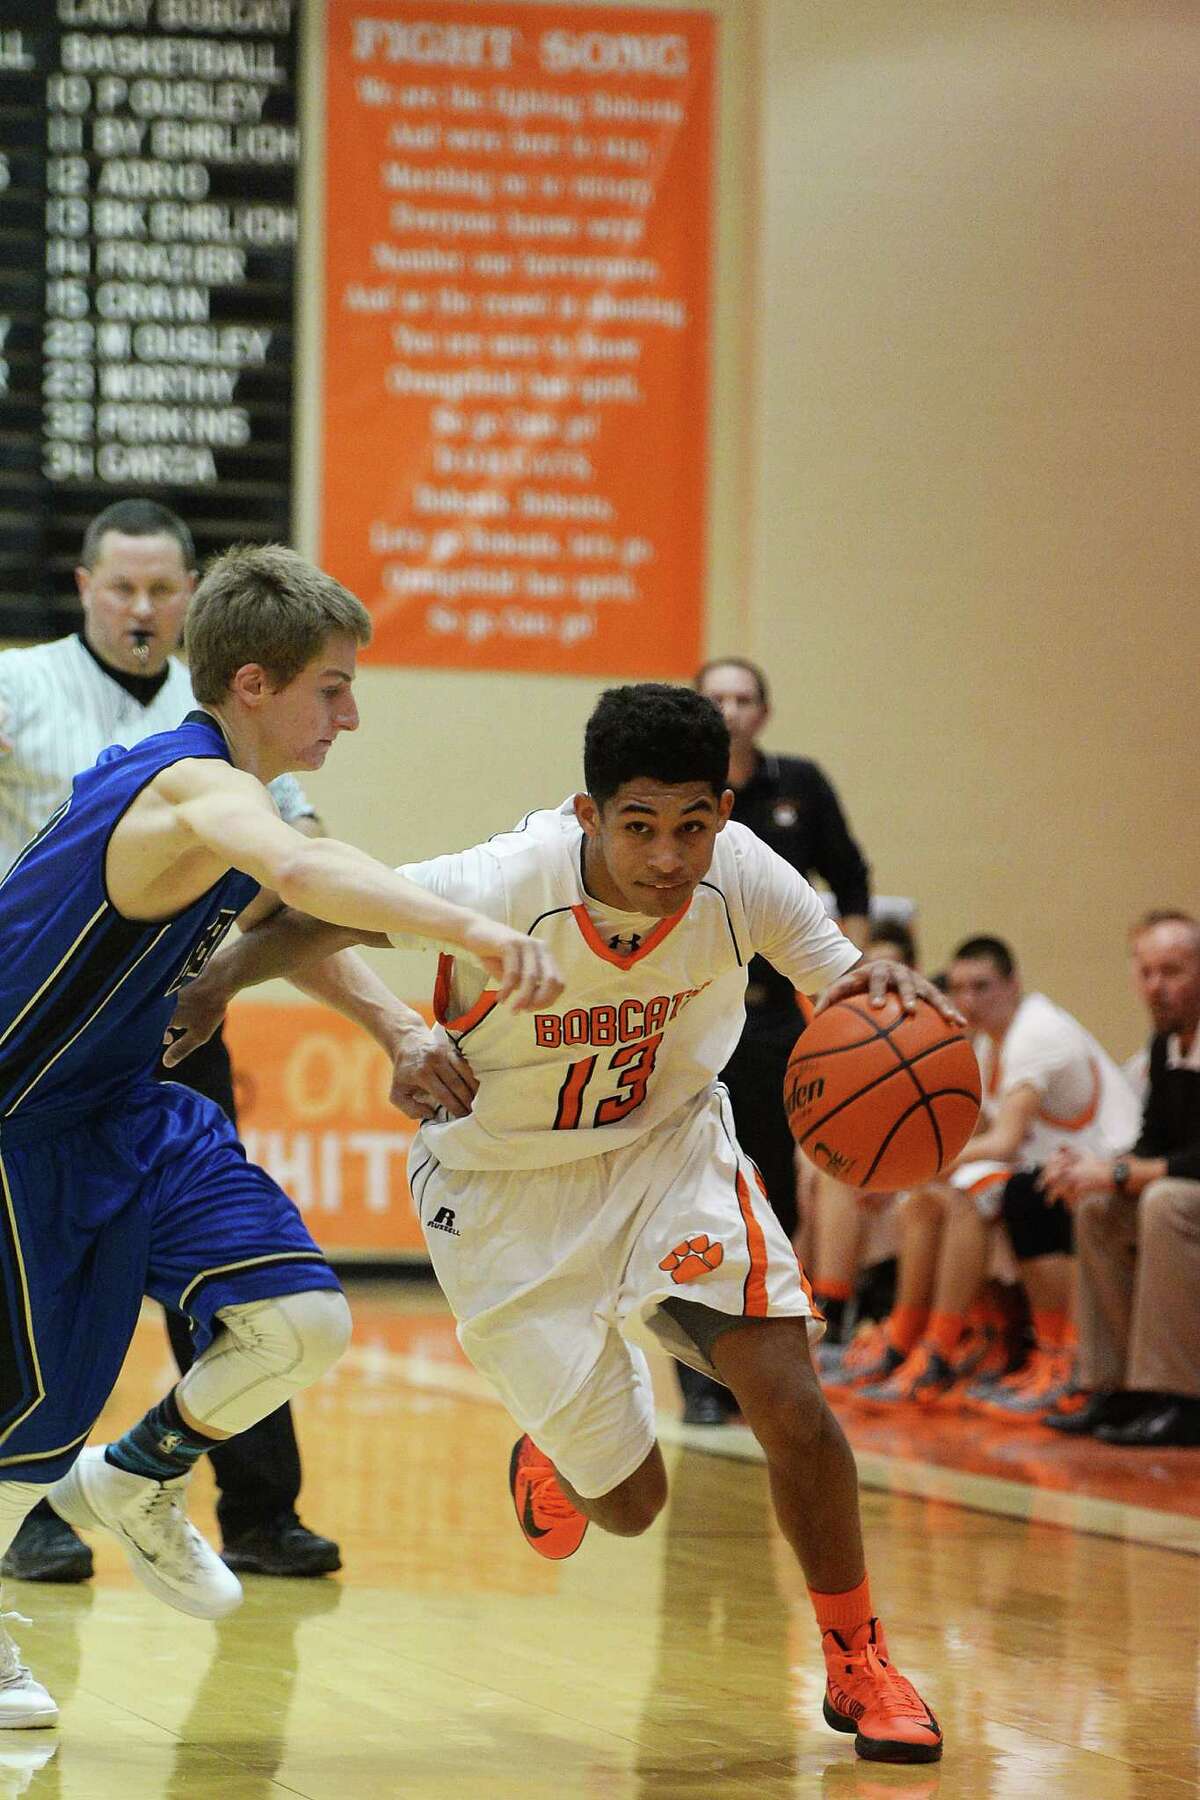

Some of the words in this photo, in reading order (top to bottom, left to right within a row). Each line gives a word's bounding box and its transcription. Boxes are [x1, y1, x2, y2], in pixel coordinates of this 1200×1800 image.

[61, 32, 286, 82] BASKETBALL
[354, 19, 516, 69] FIGHT
[541, 31, 687, 75] SONG
[534, 979, 712, 1048] BOBCAT
[552, 1032, 664, 1131] 13
[427, 1221, 461, 1237] RUSSELL
